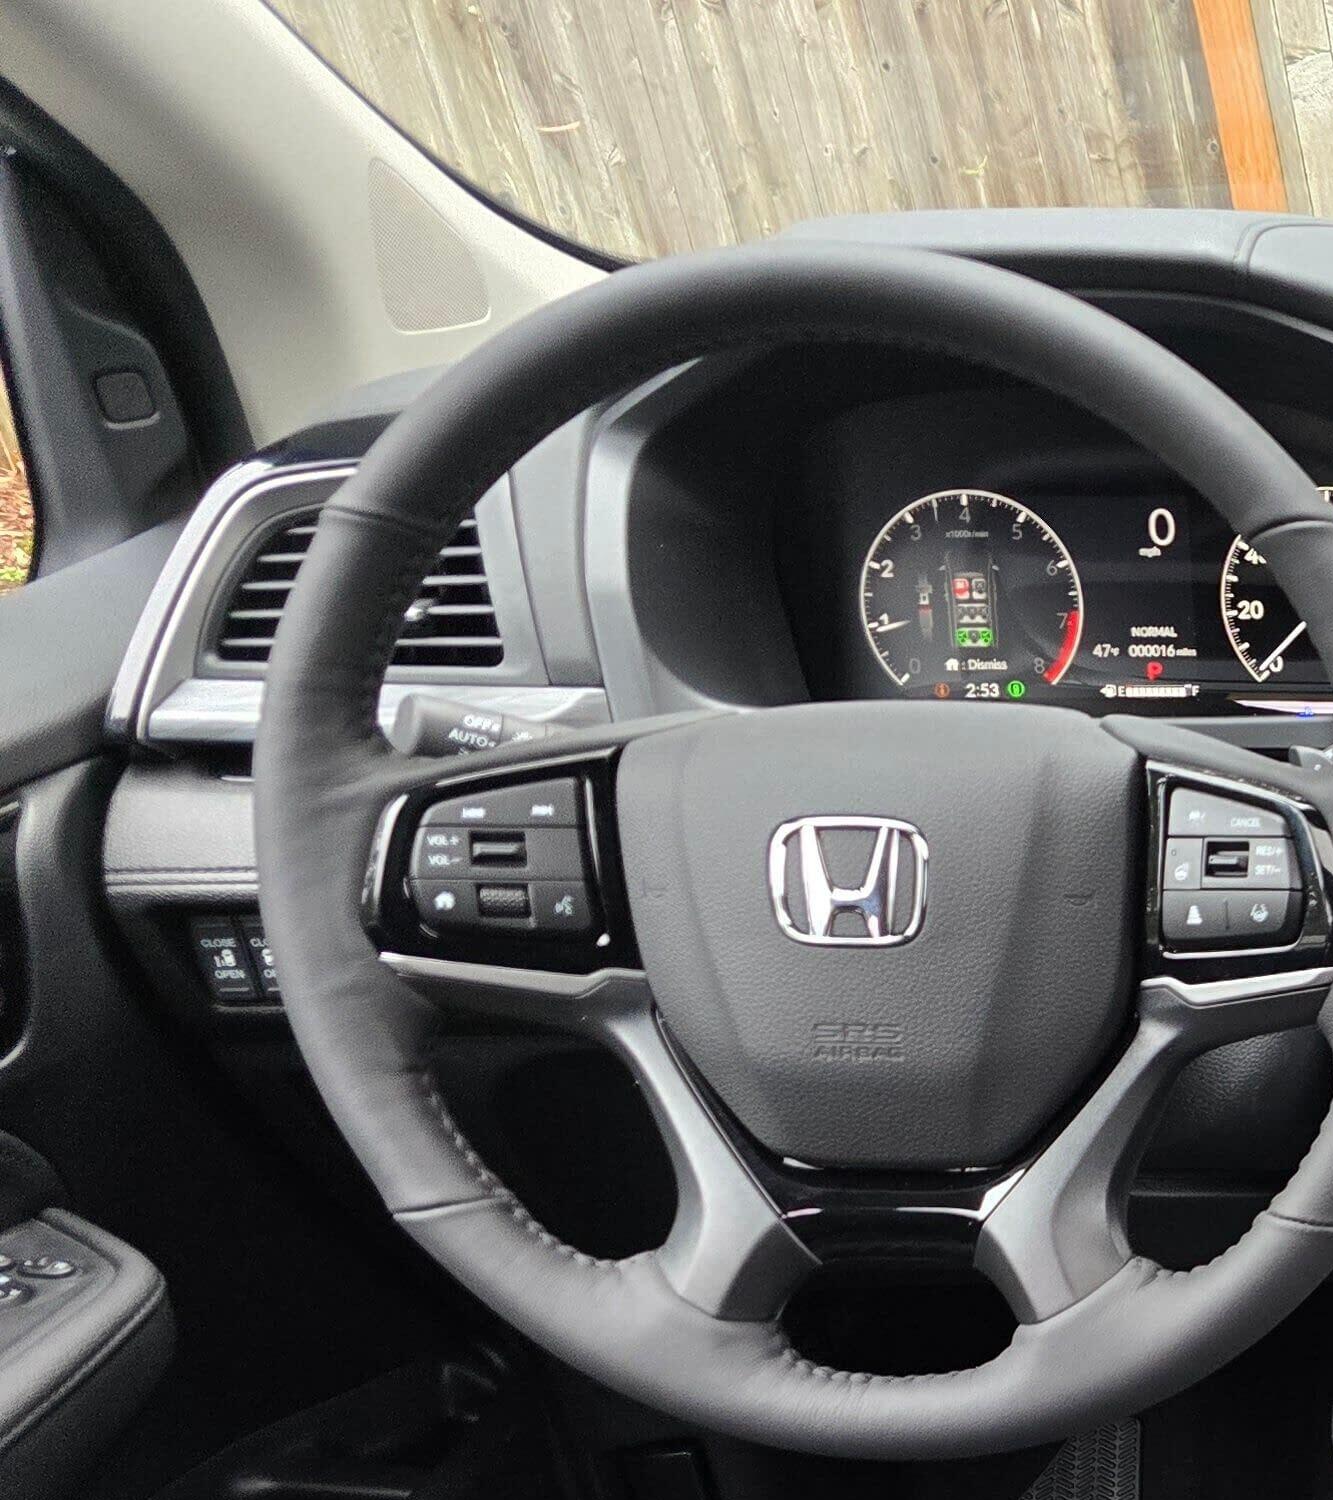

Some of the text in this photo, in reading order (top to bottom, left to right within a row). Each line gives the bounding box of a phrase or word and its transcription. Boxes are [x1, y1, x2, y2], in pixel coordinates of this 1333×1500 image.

[959, 507, 971, 523] 4
[911, 525, 922, 541] 3
[1012, 524, 1023, 540] 5
[1148, 507, 1176, 546] 0
[880, 560, 895, 578] 2
[1046, 560, 1058, 576] 6
[1237, 600, 1264, 620] 20
[1056, 612, 1067, 629] 7
[1130, 626, 1178, 638] NORMAL
[1128, 644, 1176, 658] 000016
[909, 658, 921, 674] 0
[968, 658, 1008, 671] Dismiss
[1033, 657, 1045, 674] 8
[1146, 661, 1163, 681] P
[965, 683, 1000, 698] 2:53
[1118, 686, 1125, 697] E
[1192, 685, 1200, 696] F
[449, 728, 487, 747] AUTO
[1230, 817, 1262, 828] CANCEL
[200, 938, 237, 948] CLOSE
